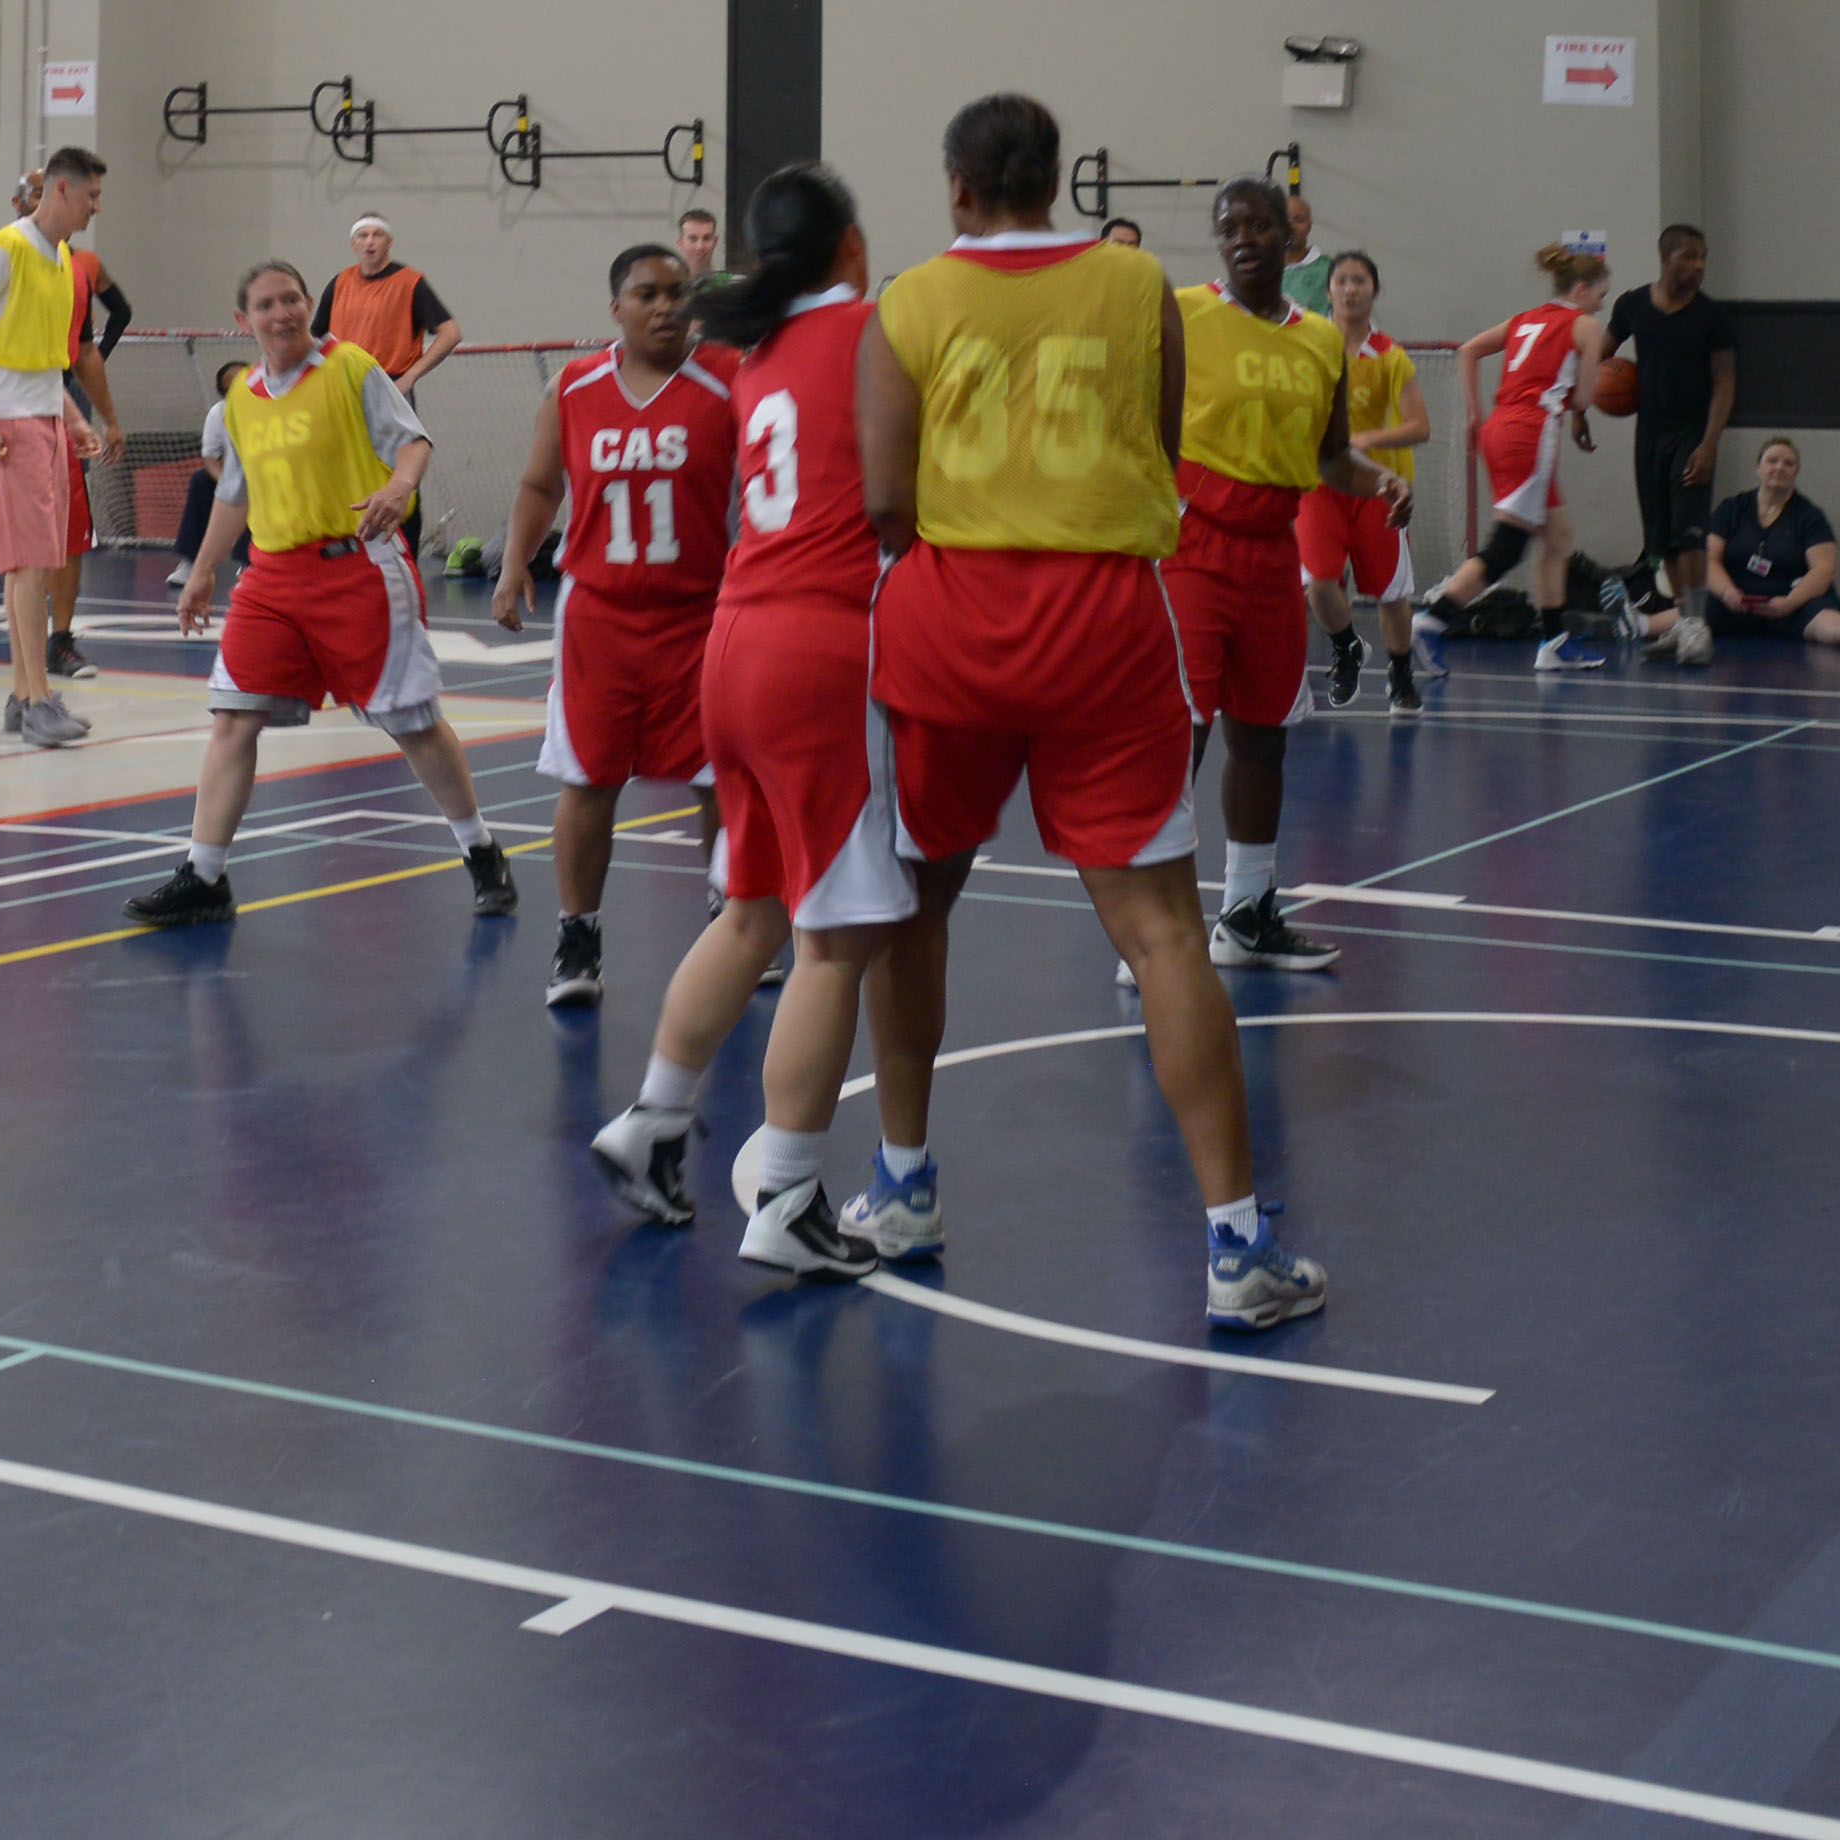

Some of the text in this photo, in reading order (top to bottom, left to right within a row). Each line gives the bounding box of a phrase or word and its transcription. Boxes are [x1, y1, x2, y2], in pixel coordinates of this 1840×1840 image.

[1507, 323, 1547, 373] 7
[1234, 350, 1316, 396] CAS
[246, 410, 311, 457] CAS
[590, 424, 689, 473] CAS
[743, 387, 799, 534] 3
[603, 478, 681, 565] 11
